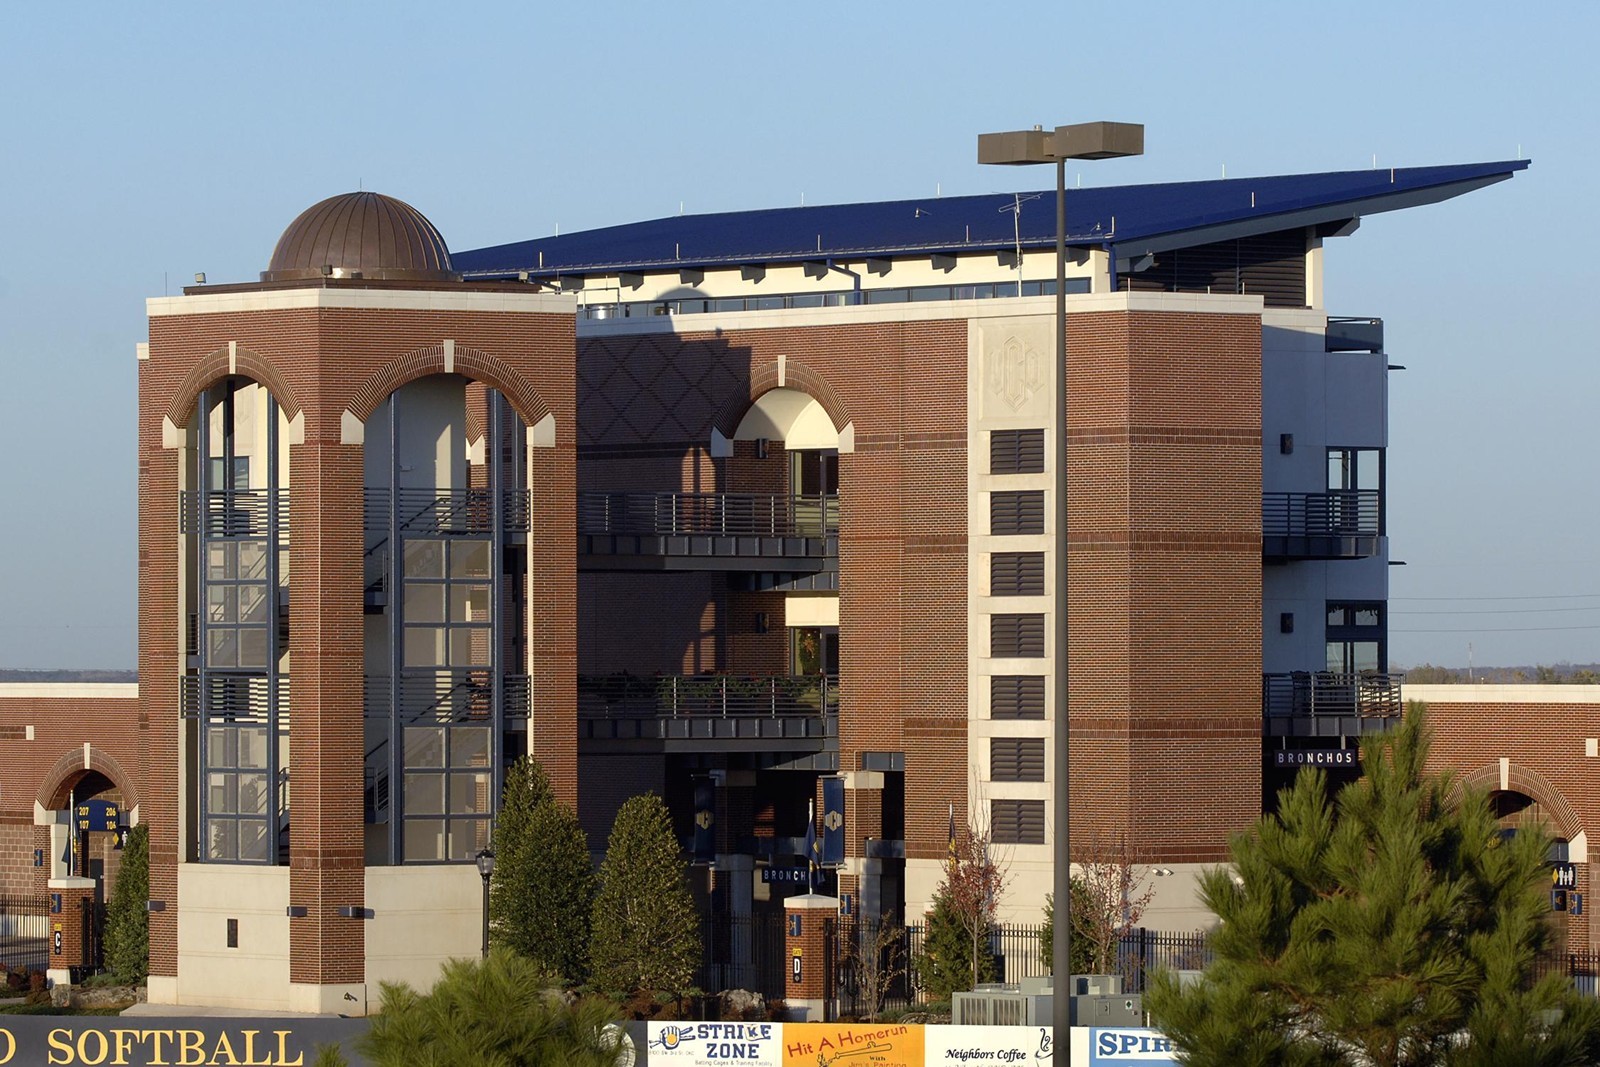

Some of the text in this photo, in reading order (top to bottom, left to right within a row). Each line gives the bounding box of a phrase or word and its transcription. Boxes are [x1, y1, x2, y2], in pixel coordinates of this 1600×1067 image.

[1278, 752, 1352, 763] BRONCHOS
[79, 806, 89, 816] 207
[105, 807, 117, 817] 206
[764, 870, 806, 880] BRONCH
[55, 932, 61, 947] C
[794, 958, 801, 974] D
[697, 1024, 771, 1040] STRIKE
[47, 1028, 303, 1066] SOFTBALL
[787, 1025, 908, 1058] Hit A Homerun
[1099, 1032, 1180, 1056] SPIR
[706, 1043, 760, 1059] ZONE
[945, 1048, 1027, 1062] Neighbors Coffee
